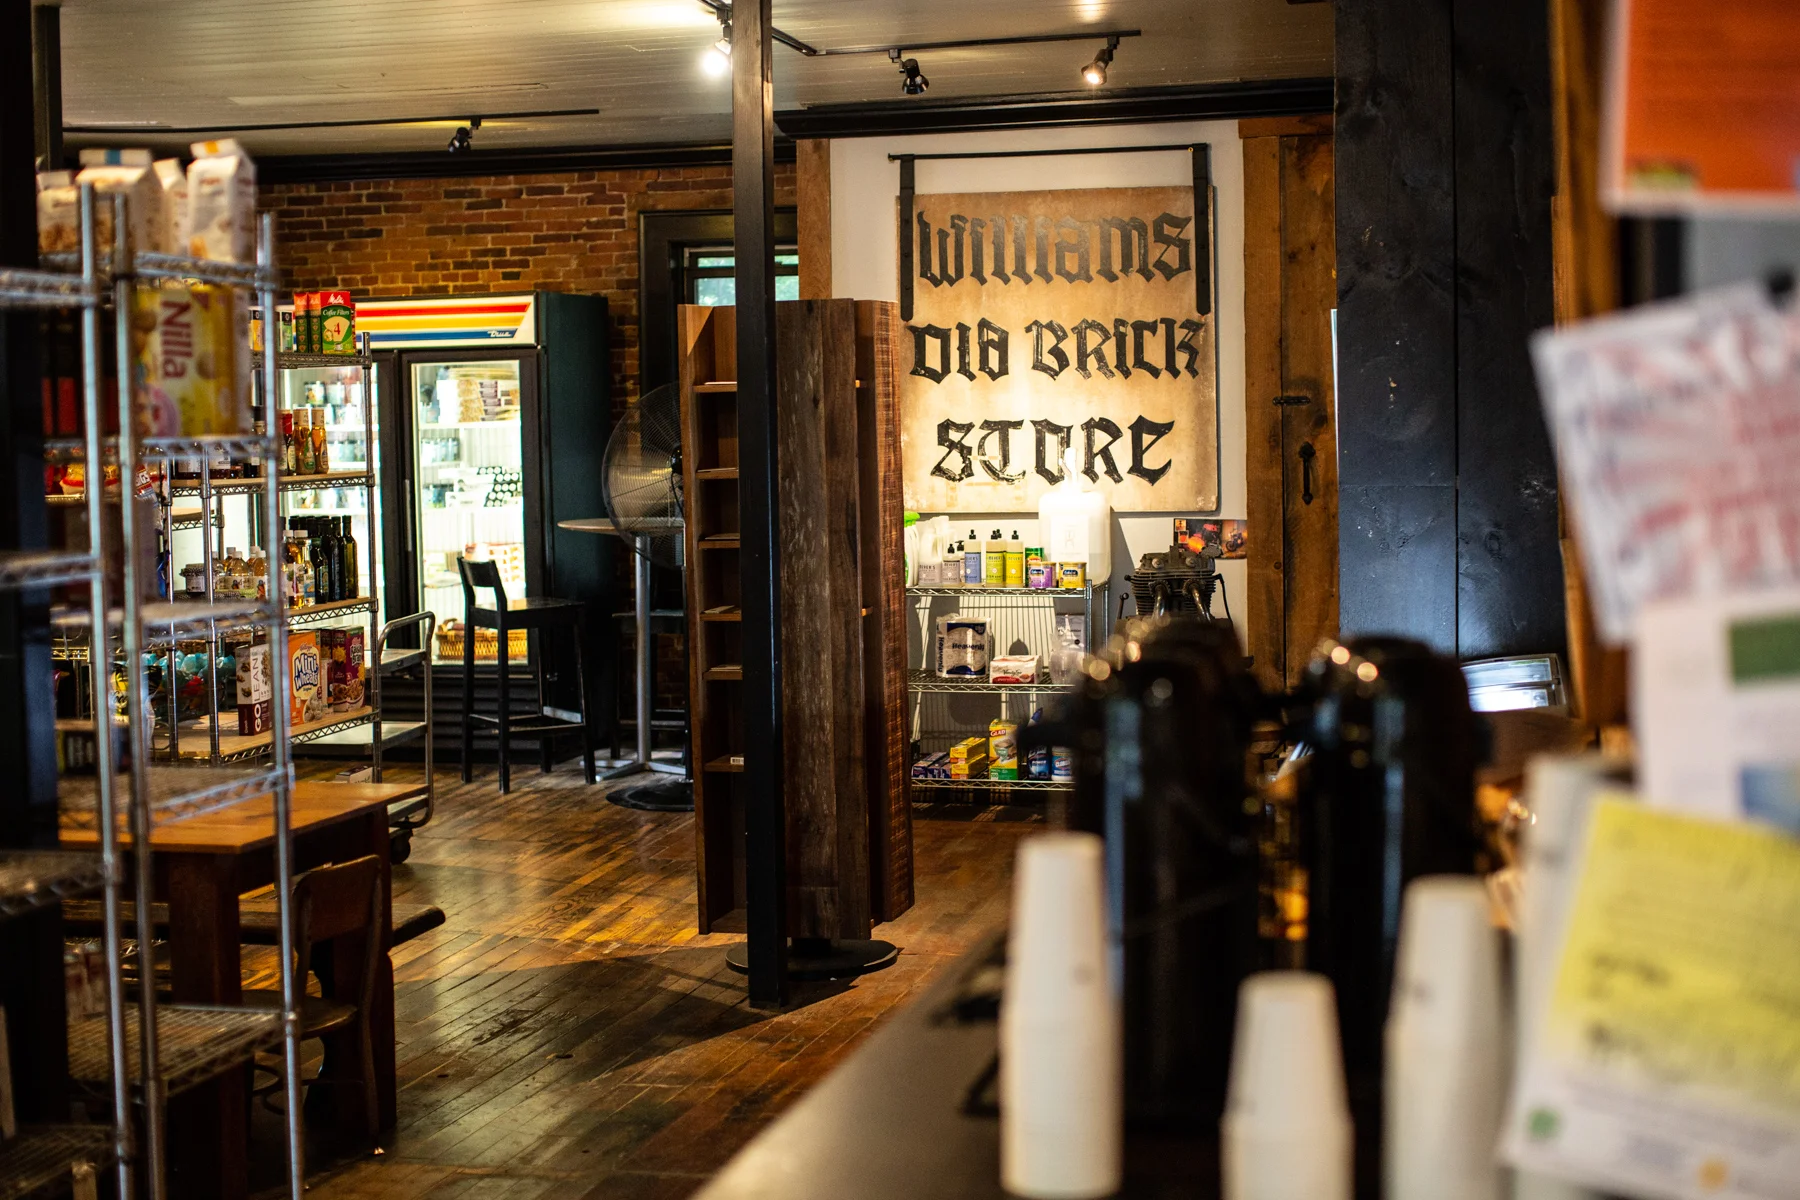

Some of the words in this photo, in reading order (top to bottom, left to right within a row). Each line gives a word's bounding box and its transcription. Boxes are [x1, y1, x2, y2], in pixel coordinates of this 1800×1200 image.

[333, 322, 341, 335] 4
[162, 300, 194, 380] Nilla
[990, 729, 1006, 737] GLAD
